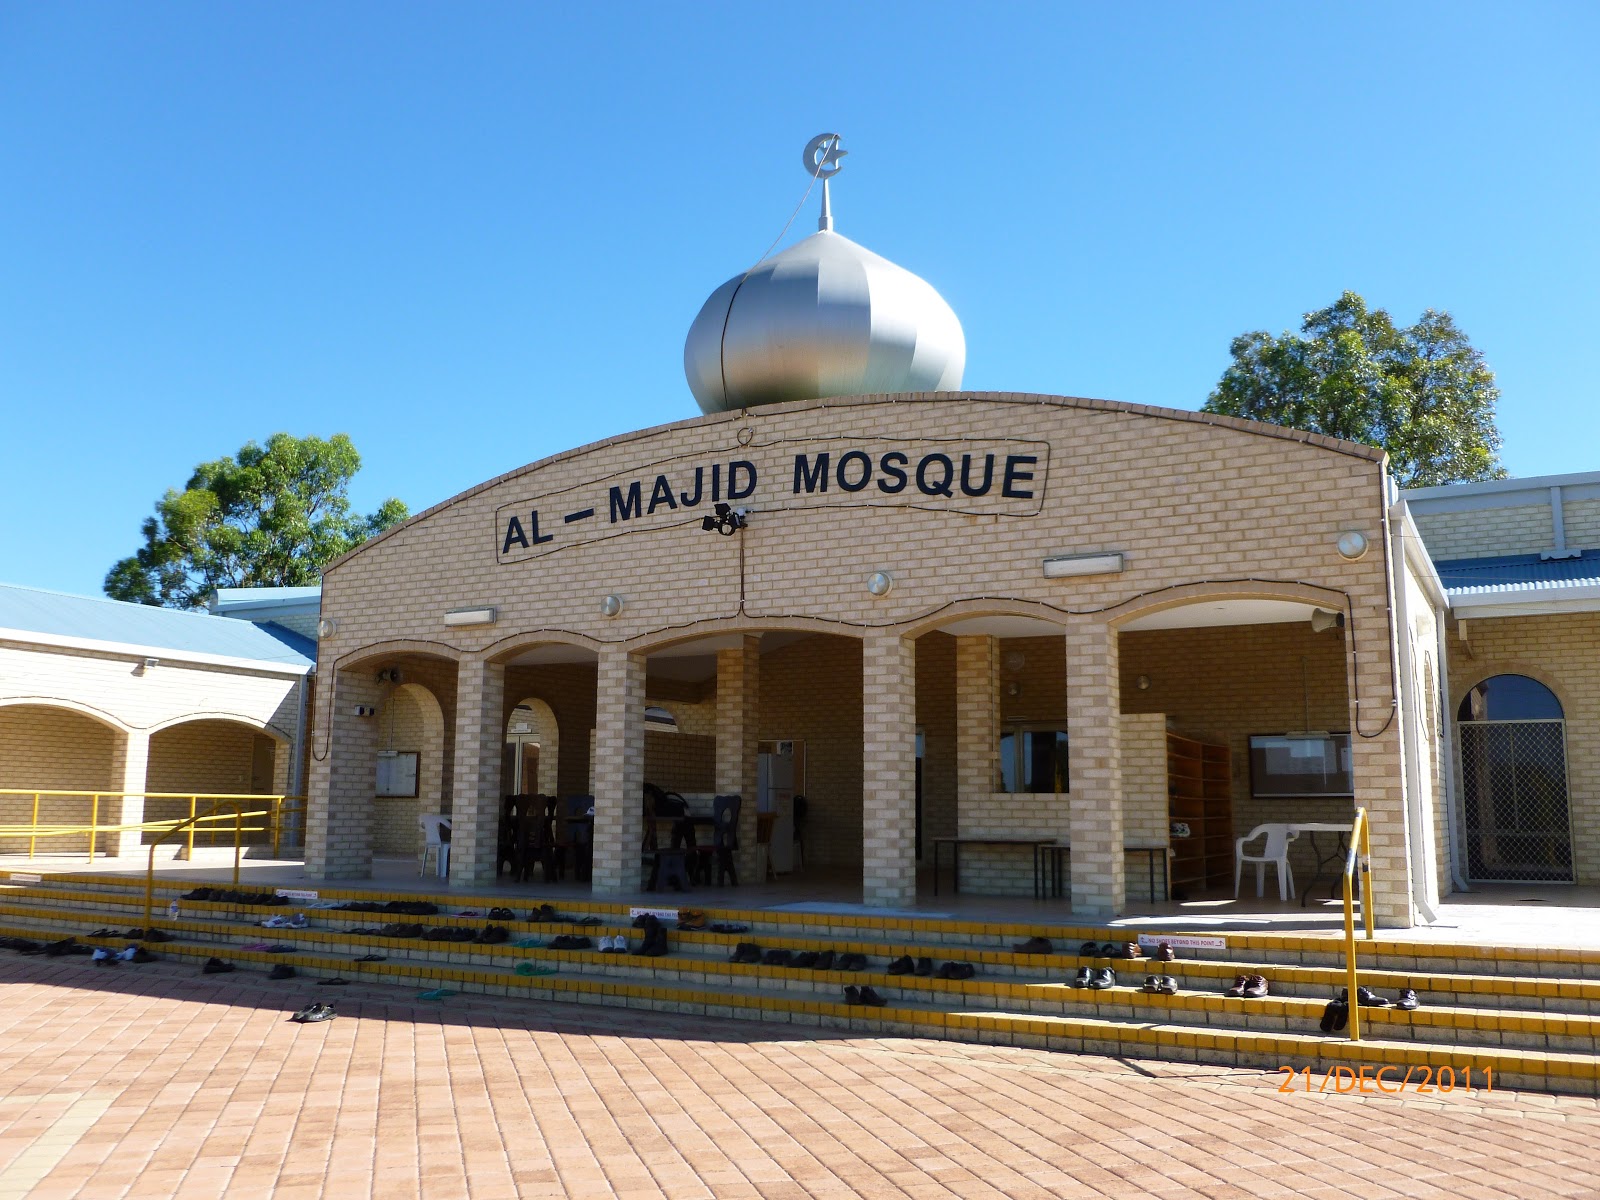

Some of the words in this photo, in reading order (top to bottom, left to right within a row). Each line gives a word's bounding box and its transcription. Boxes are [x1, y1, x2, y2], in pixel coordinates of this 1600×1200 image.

[502, 509, 555, 555] AL
[608, 459, 758, 523] MAJID
[792, 450, 1039, 500] MOSQUE
